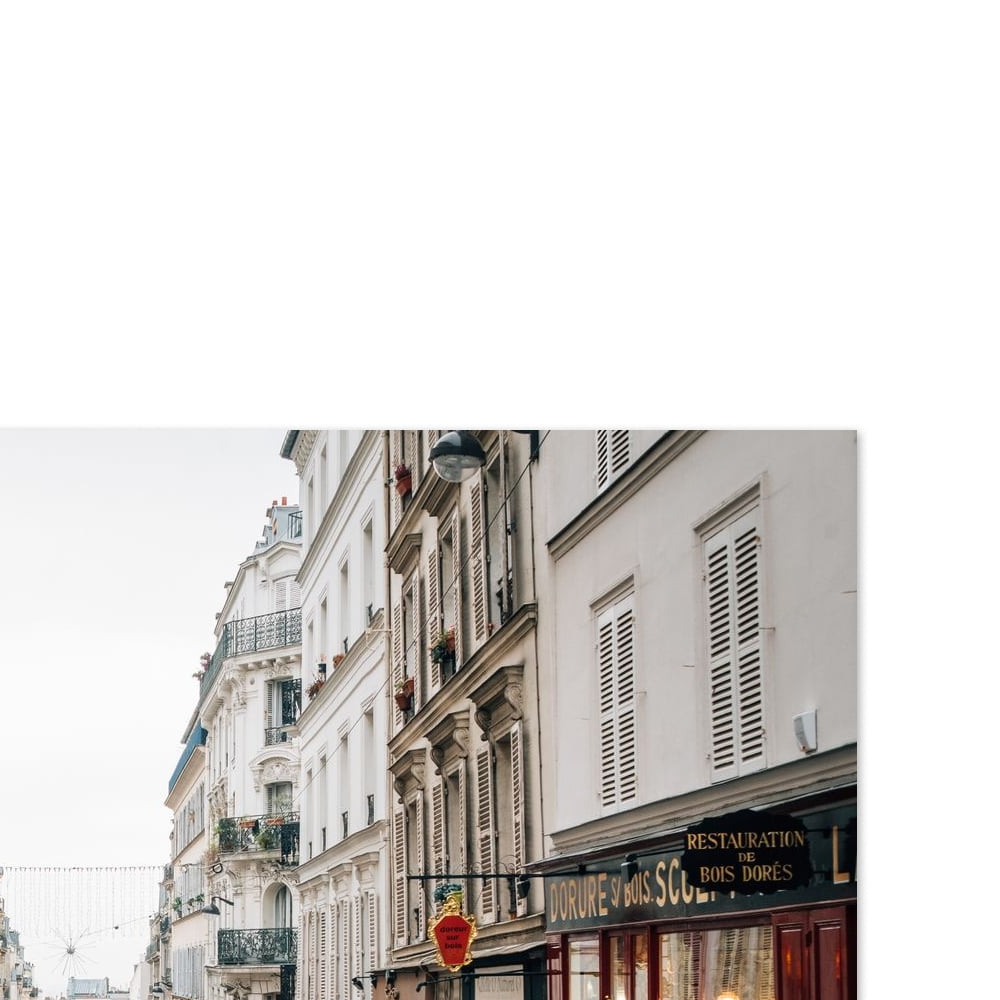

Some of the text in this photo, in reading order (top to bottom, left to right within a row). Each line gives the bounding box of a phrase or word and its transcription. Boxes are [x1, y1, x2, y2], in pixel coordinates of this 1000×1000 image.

[687, 830, 805, 850] RESTAURATION
[738, 851, 756, 863] DE
[700, 860, 793, 883] BOIS DORÉS
[550, 873, 608, 922] DORURE
